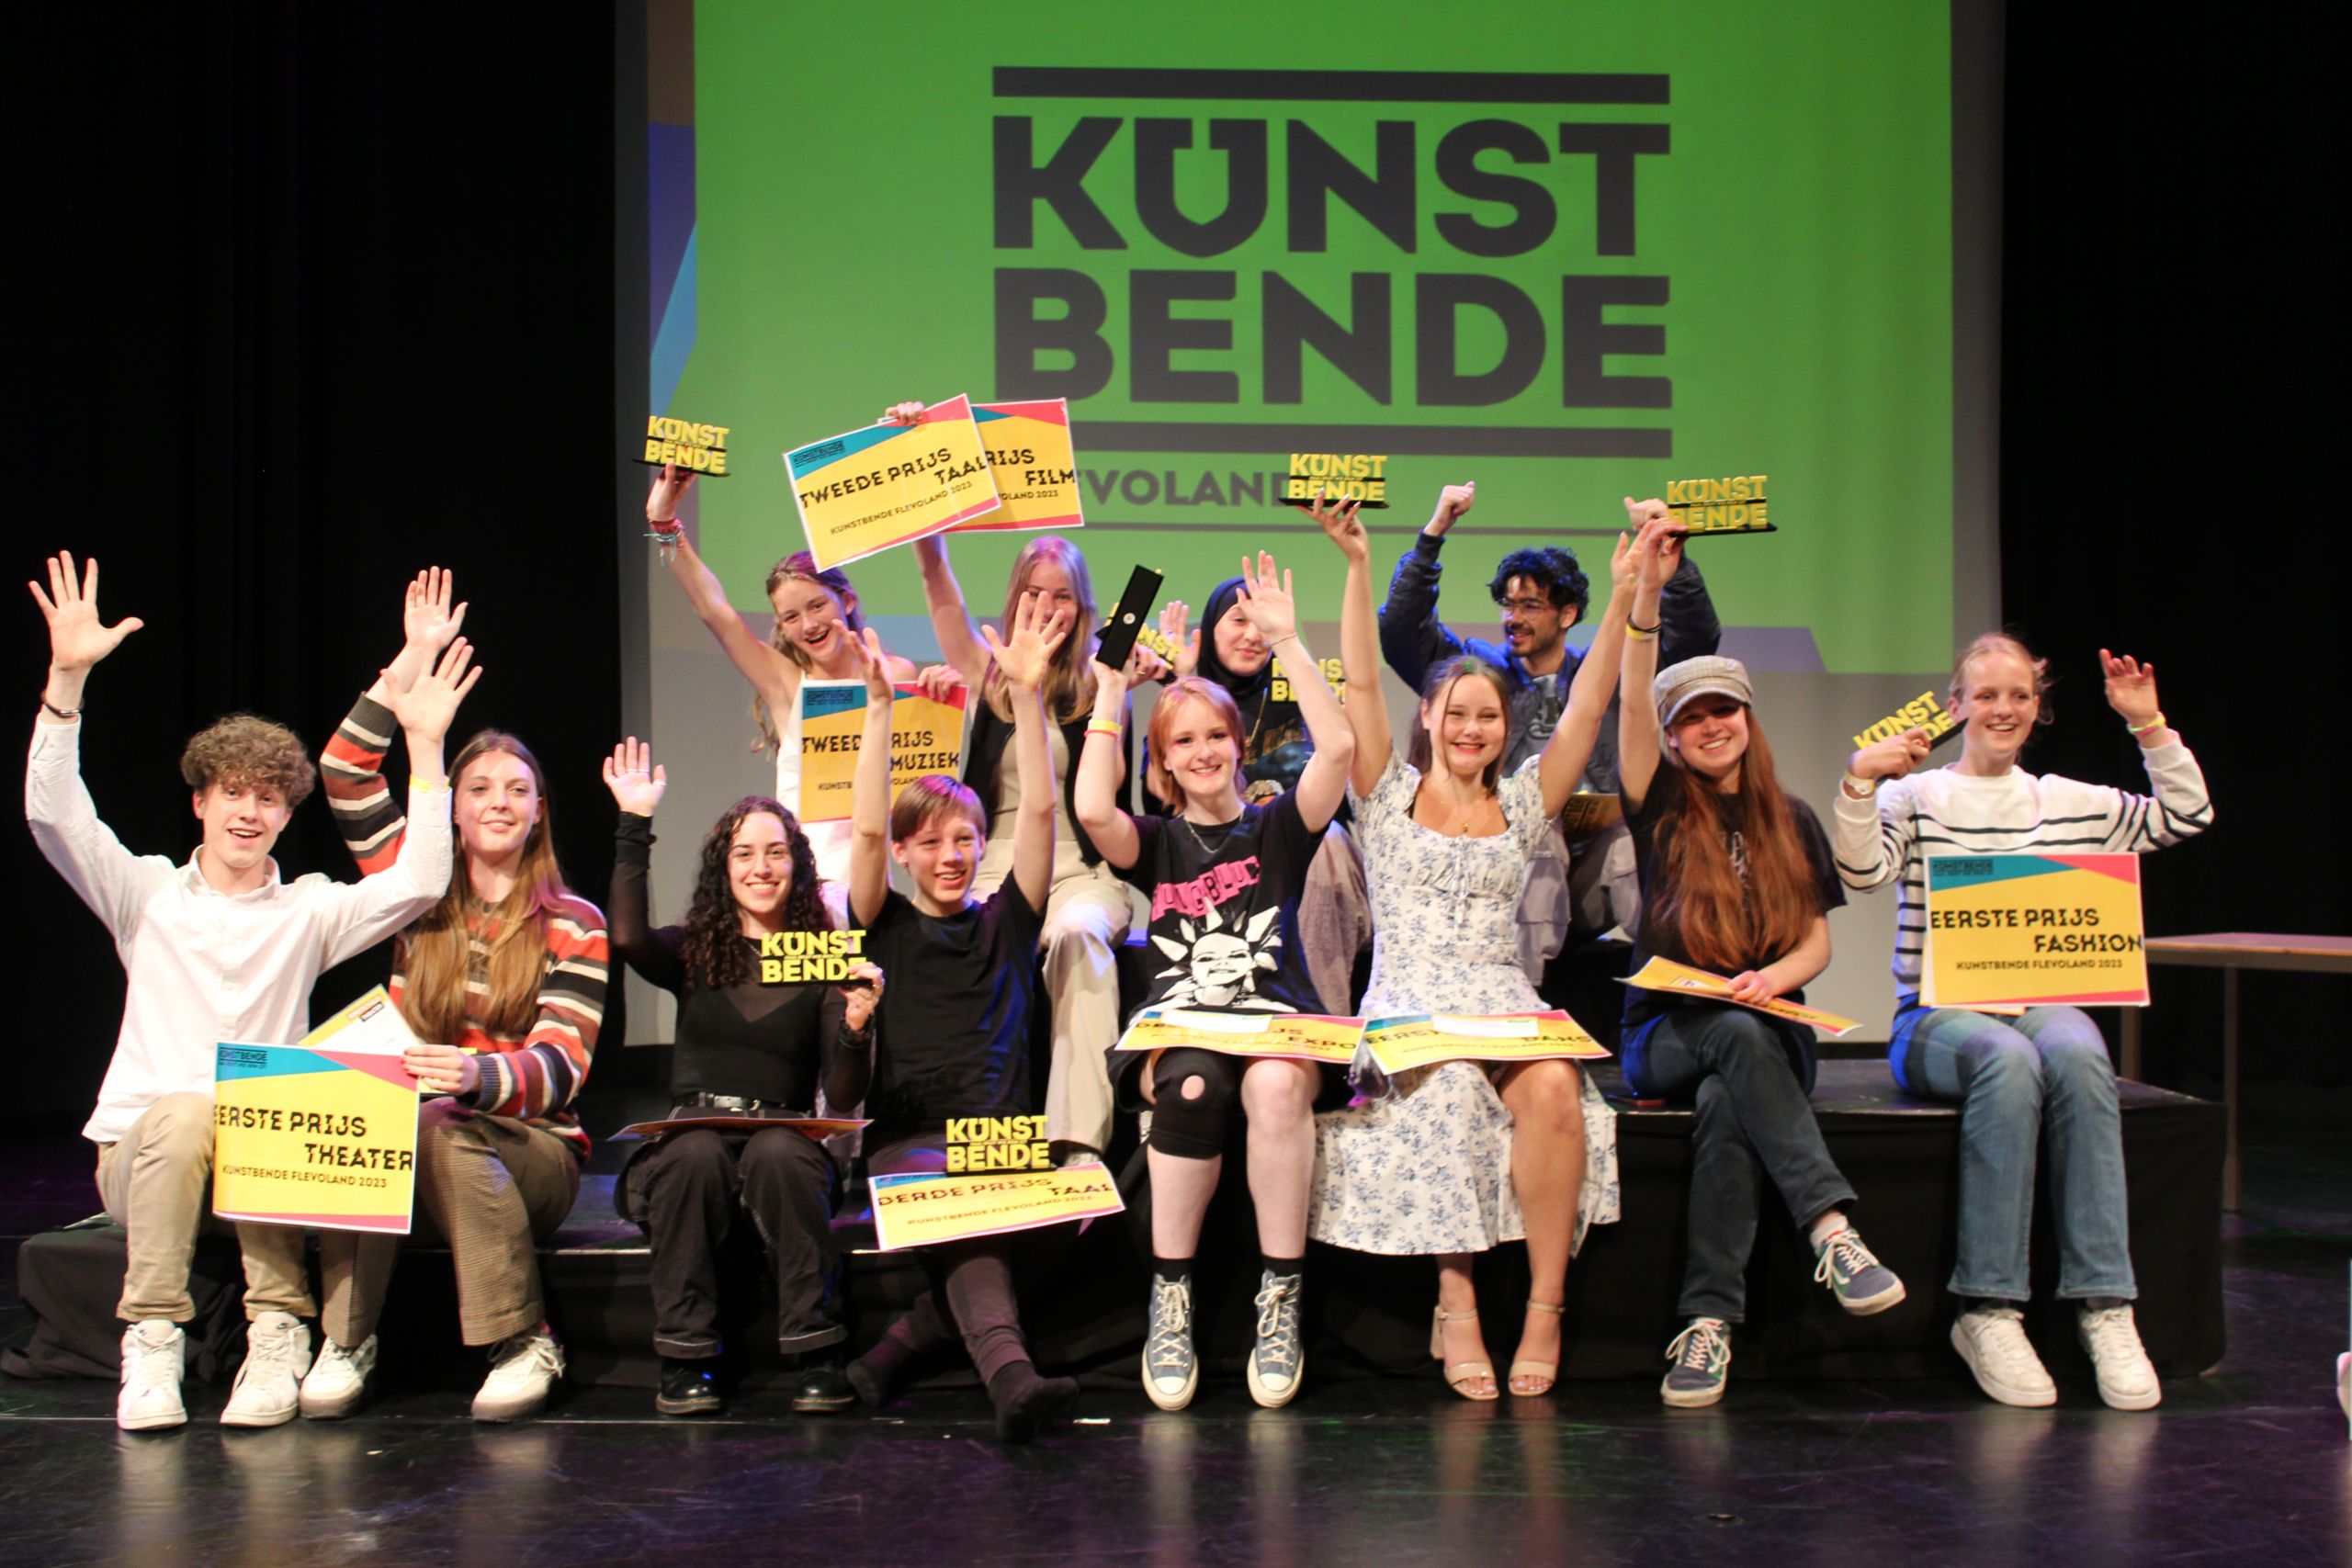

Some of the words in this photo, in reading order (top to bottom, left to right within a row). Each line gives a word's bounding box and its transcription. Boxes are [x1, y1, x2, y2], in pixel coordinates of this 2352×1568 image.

[993, 115, 1670, 258] KUNST
[993, 266, 1673, 409] BENDE
[647, 415, 730, 448] KUNST
[644, 439, 728, 474] BENDE
[985, 448, 1035, 467] RIJS
[1288, 453, 1388, 478] KUNST
[799, 471, 884, 509] TWEEDE
[889, 447, 952, 482] PRIJS
[934, 456, 988, 486] TAAL
[1024, 468, 1075, 487] FILM
[1035, 490, 1058, 498] 2023
[1287, 479, 1385, 502] BENDE
[1667, 475, 1768, 504] KUNST
[831, 509, 893, 535] KUNSTBENDE
[895, 490, 948, 515] FLEVOLAND
[951, 480, 973, 494] 2023
[1852, 691, 1940, 750] KUNST
[801, 735, 862, 753] TWEED
[891, 730, 933, 748] RIJS
[889, 751, 959, 772] MUZIEK
[1930, 908, 2018, 929] EERSTE
[2024, 908, 2100, 928] PRIJS
[761, 930, 867, 956] KUNST
[2034, 934, 2143, 953] FASHION
[1956, 960, 2030, 970] KUNSTBENDE
[2032, 959, 2096, 969] FLEVOLAND
[2098, 959, 2123, 968] 2023
[289, 1111, 368, 1138] PRIJS
[946, 1115, 1049, 1143] KUNST
[305, 1143, 413, 1171] THEATER
[946, 1143, 1050, 1172] BENDE
[221, 1165, 288, 1180] KUNSTBENDE
[291, 1170, 356, 1186] FLEVOLAND
[359, 1177, 388, 1189] 2023
[1047, 1183, 1114, 1196] TAAL
[878, 1186, 964, 1206] DERDE
[971, 1178, 1053, 1195] PRIJS
[908, 1208, 989, 1225] KUNSTBENDE
[991, 1198, 1061, 1213] FLEVOLAND
